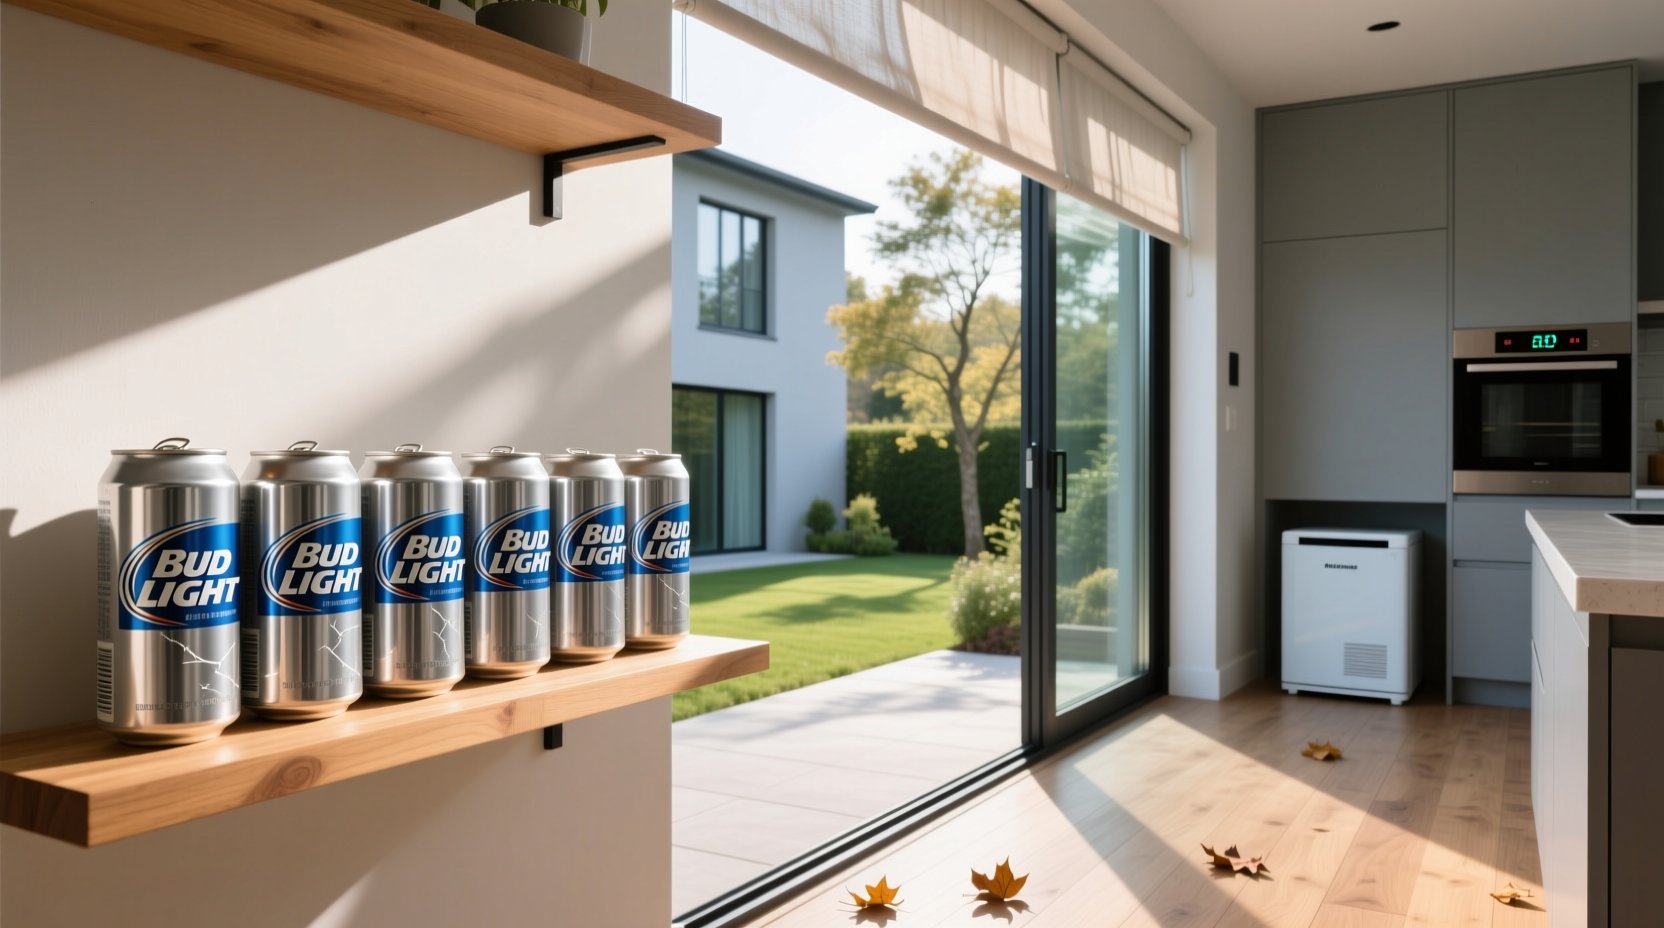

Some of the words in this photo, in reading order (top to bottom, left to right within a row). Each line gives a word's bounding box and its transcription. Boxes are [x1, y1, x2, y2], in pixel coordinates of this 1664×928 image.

[500, 529, 549, 552] BUD
[581, 524, 625, 545] BUD
[652, 520, 689, 540] BUD
[291, 542, 359, 569] BUD
[403, 534, 462, 560] BUD
[642, 539, 690, 560] LIGH
[152, 549, 232, 578] BUD
[390, 559, 466, 585] LIGHT
[488, 551, 551, 574] LIGHT
[136, 576, 240, 608] LIGHT
[278, 567, 362, 595] LIGHT
